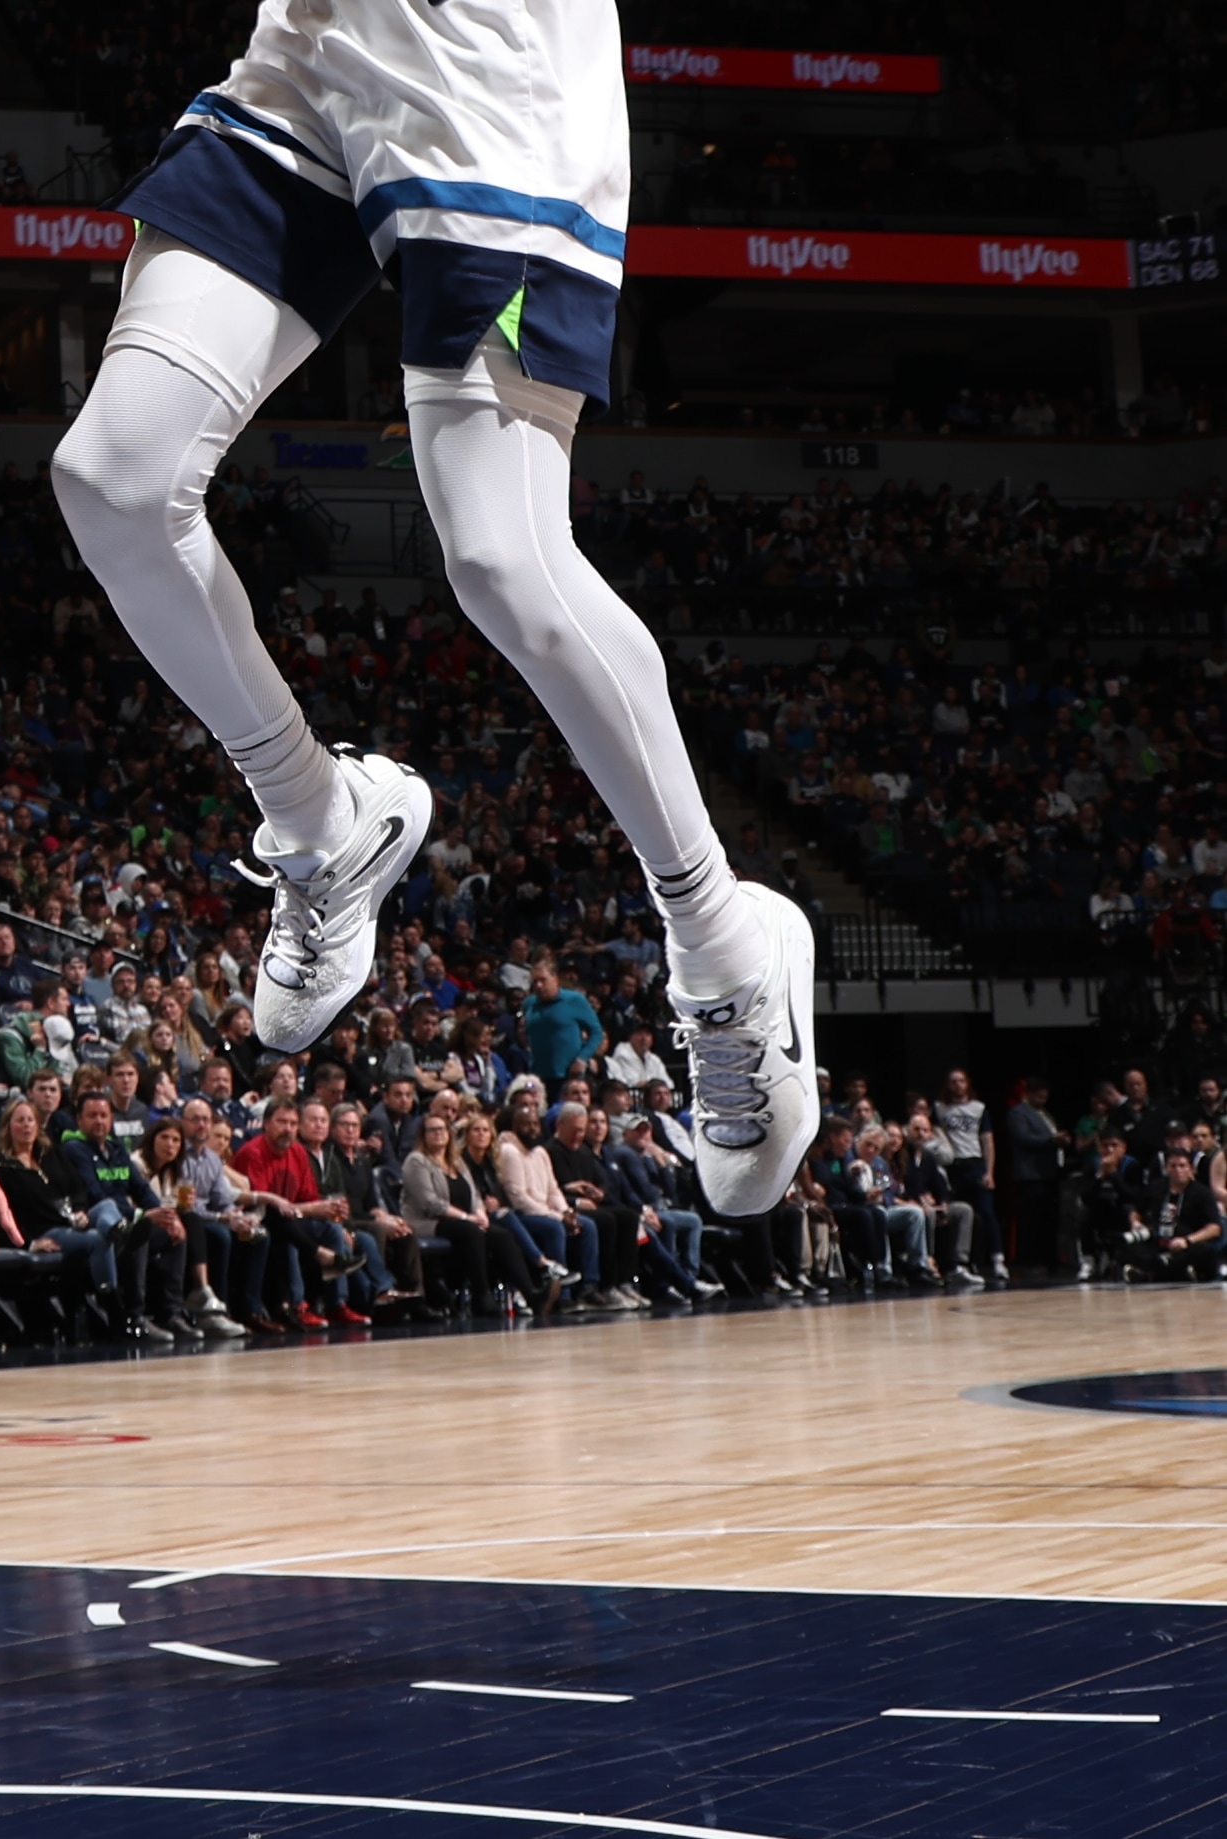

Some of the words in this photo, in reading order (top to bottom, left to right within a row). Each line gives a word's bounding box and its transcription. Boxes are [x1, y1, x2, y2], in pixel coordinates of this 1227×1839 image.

[1137, 239, 1181, 264] SAC
[1188, 235, 1215, 257] 71
[1140, 262, 1183, 287] DEN
[822, 445, 860, 466] 118
